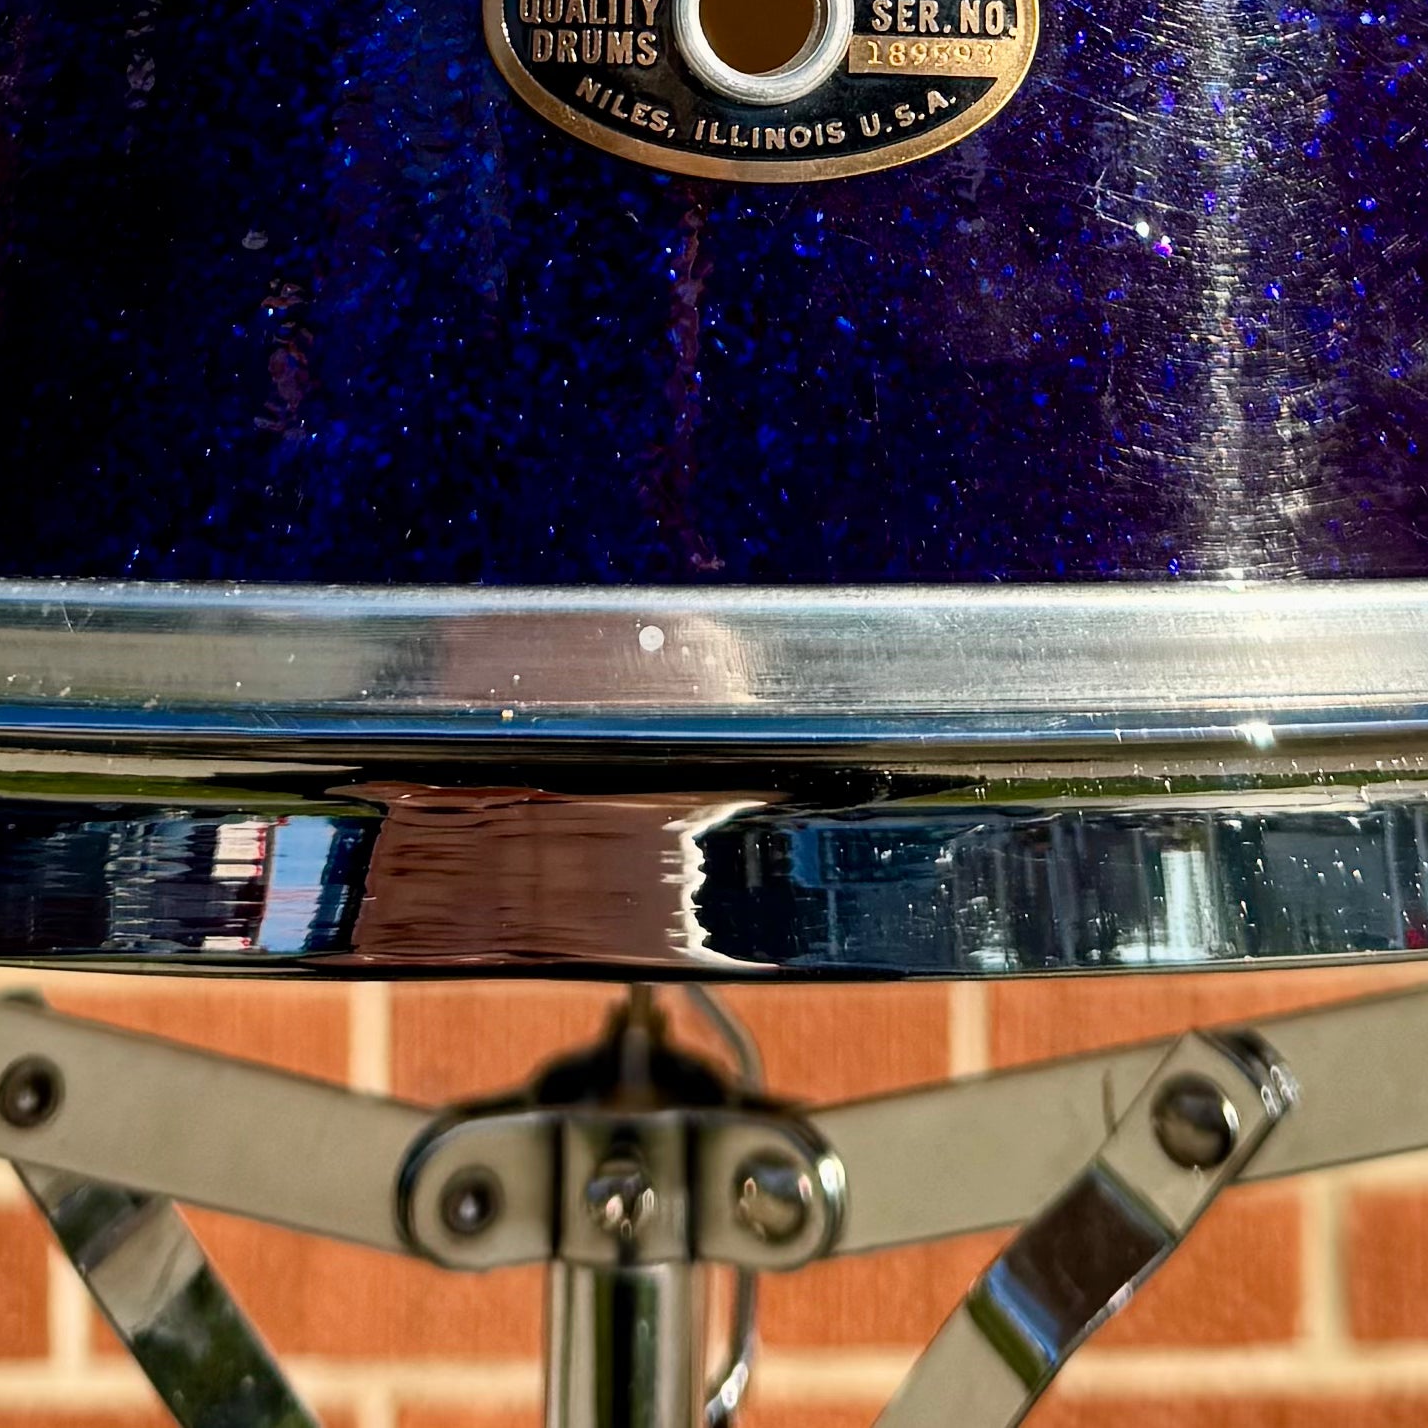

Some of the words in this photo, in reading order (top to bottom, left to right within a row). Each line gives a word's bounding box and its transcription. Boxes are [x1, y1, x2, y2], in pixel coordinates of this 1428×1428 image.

[531, 30, 660, 66] DRUMS
[575, 76, 677, 139] NILES,
[693, 118, 847, 151] ILLINOIS
